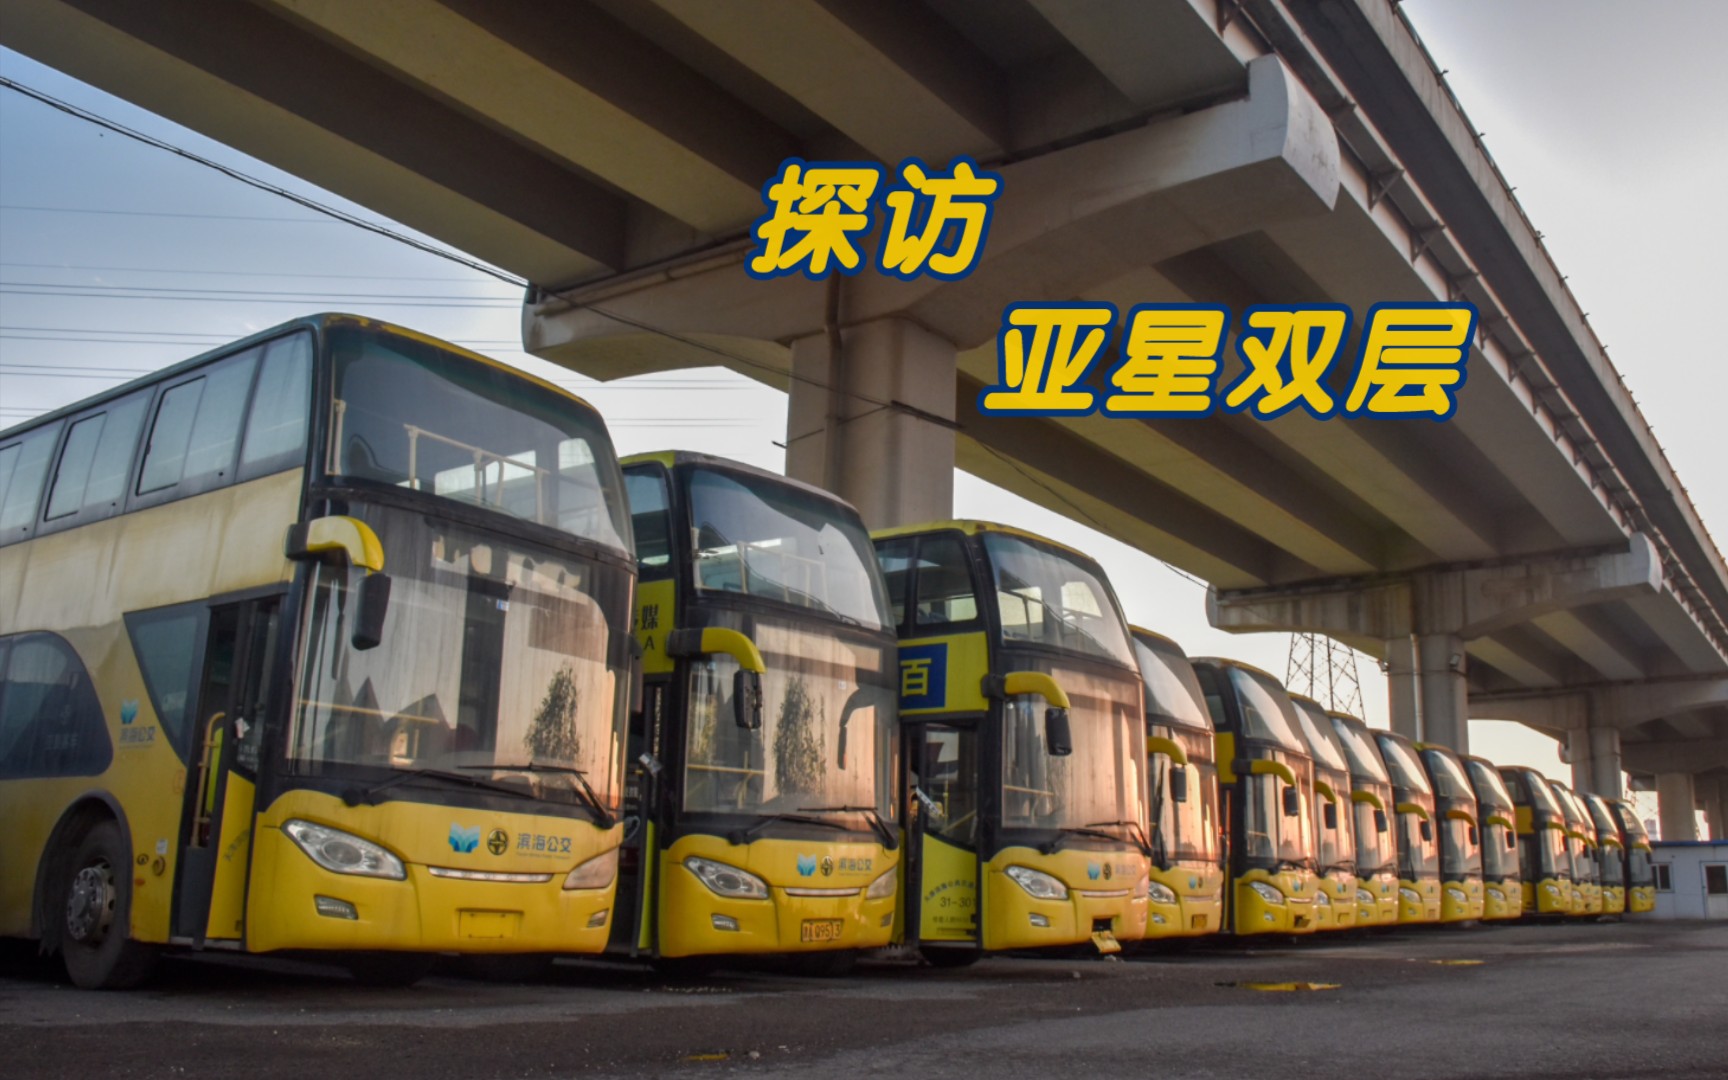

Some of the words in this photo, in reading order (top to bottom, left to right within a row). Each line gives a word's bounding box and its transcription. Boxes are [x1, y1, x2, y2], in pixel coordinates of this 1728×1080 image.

[900, 658, 932, 697] 百
[516, 832, 572, 853] 滨海公交
